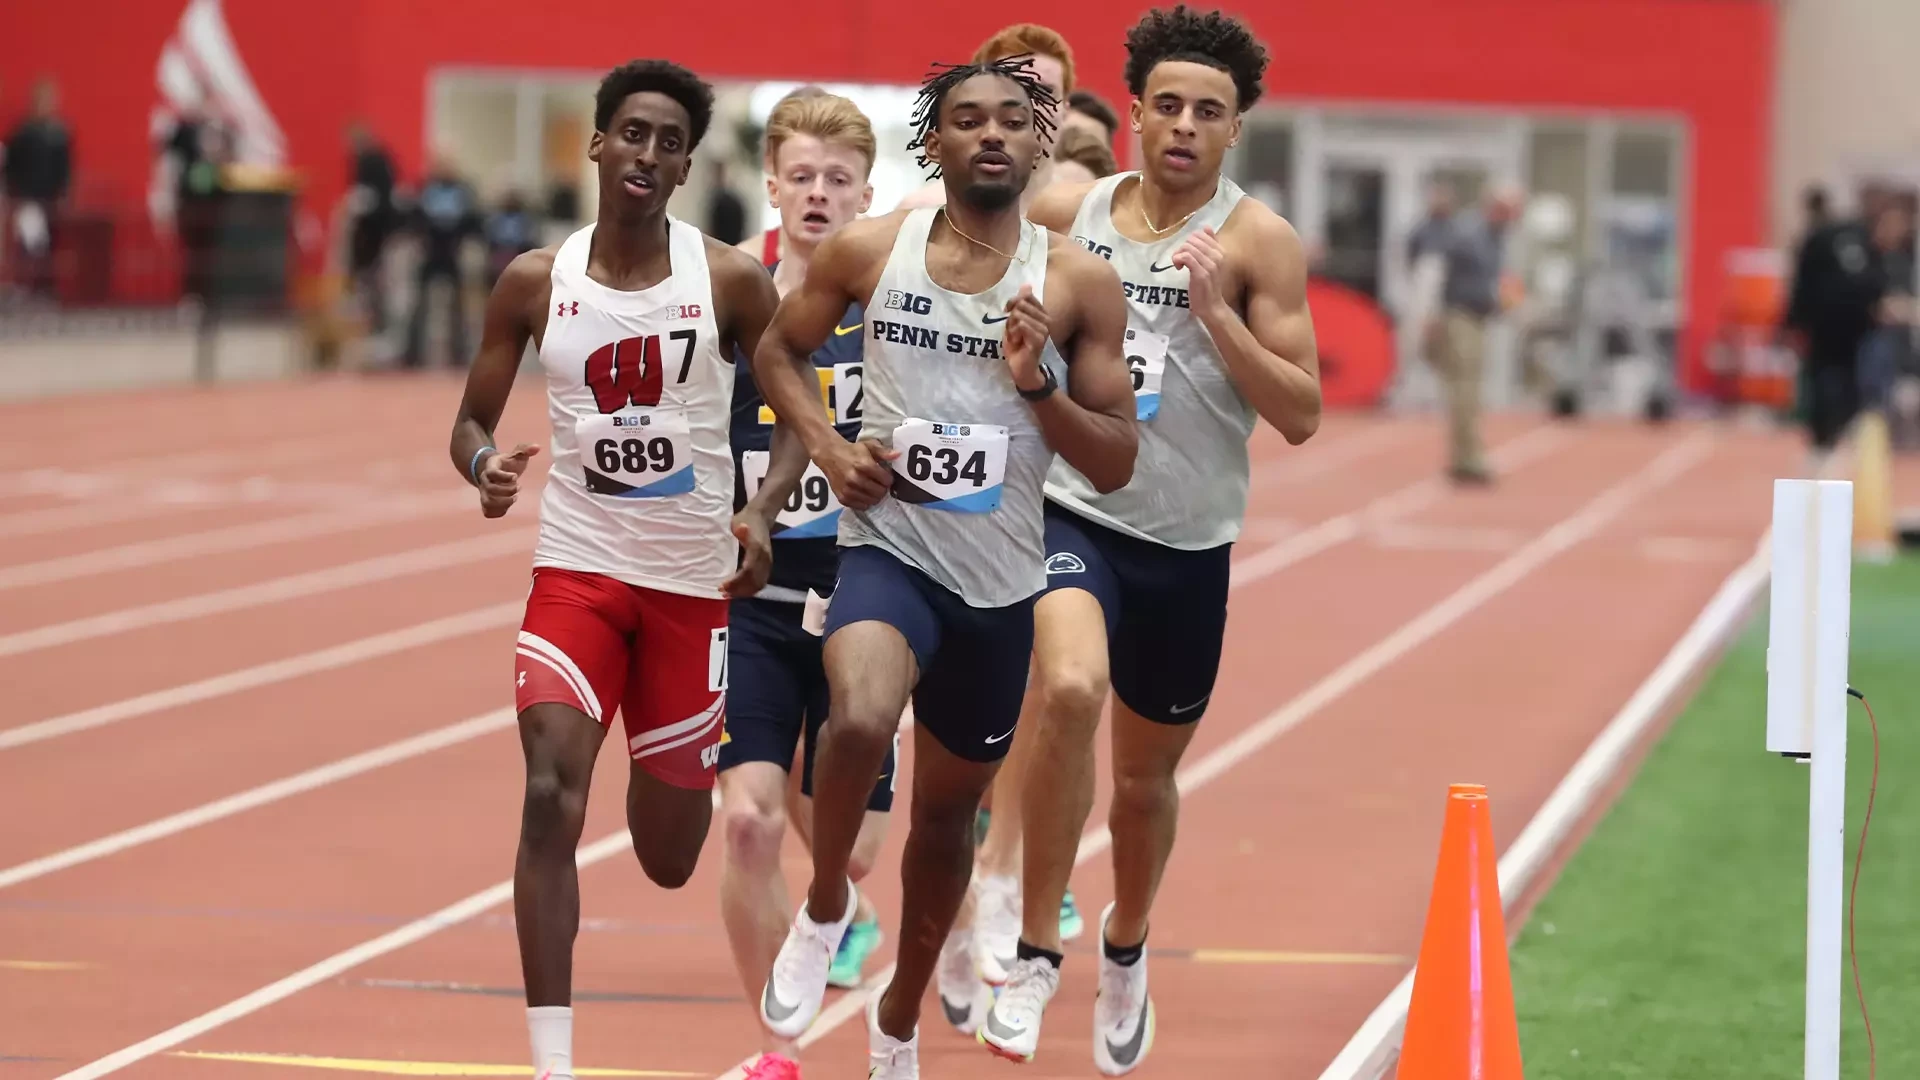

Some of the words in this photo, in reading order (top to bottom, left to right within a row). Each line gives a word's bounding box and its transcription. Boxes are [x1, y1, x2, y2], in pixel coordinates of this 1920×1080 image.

[1122, 281, 1190, 308] STATE
[669, 328, 697, 384] 7
[873, 320, 940, 350] PENN
[946, 333, 1006, 360] STA
[584, 334, 664, 414] W
[844, 366, 864, 420] 2
[594, 436, 675, 474] 689
[906, 443, 987, 487] 634
[757, 475, 829, 512] 09
